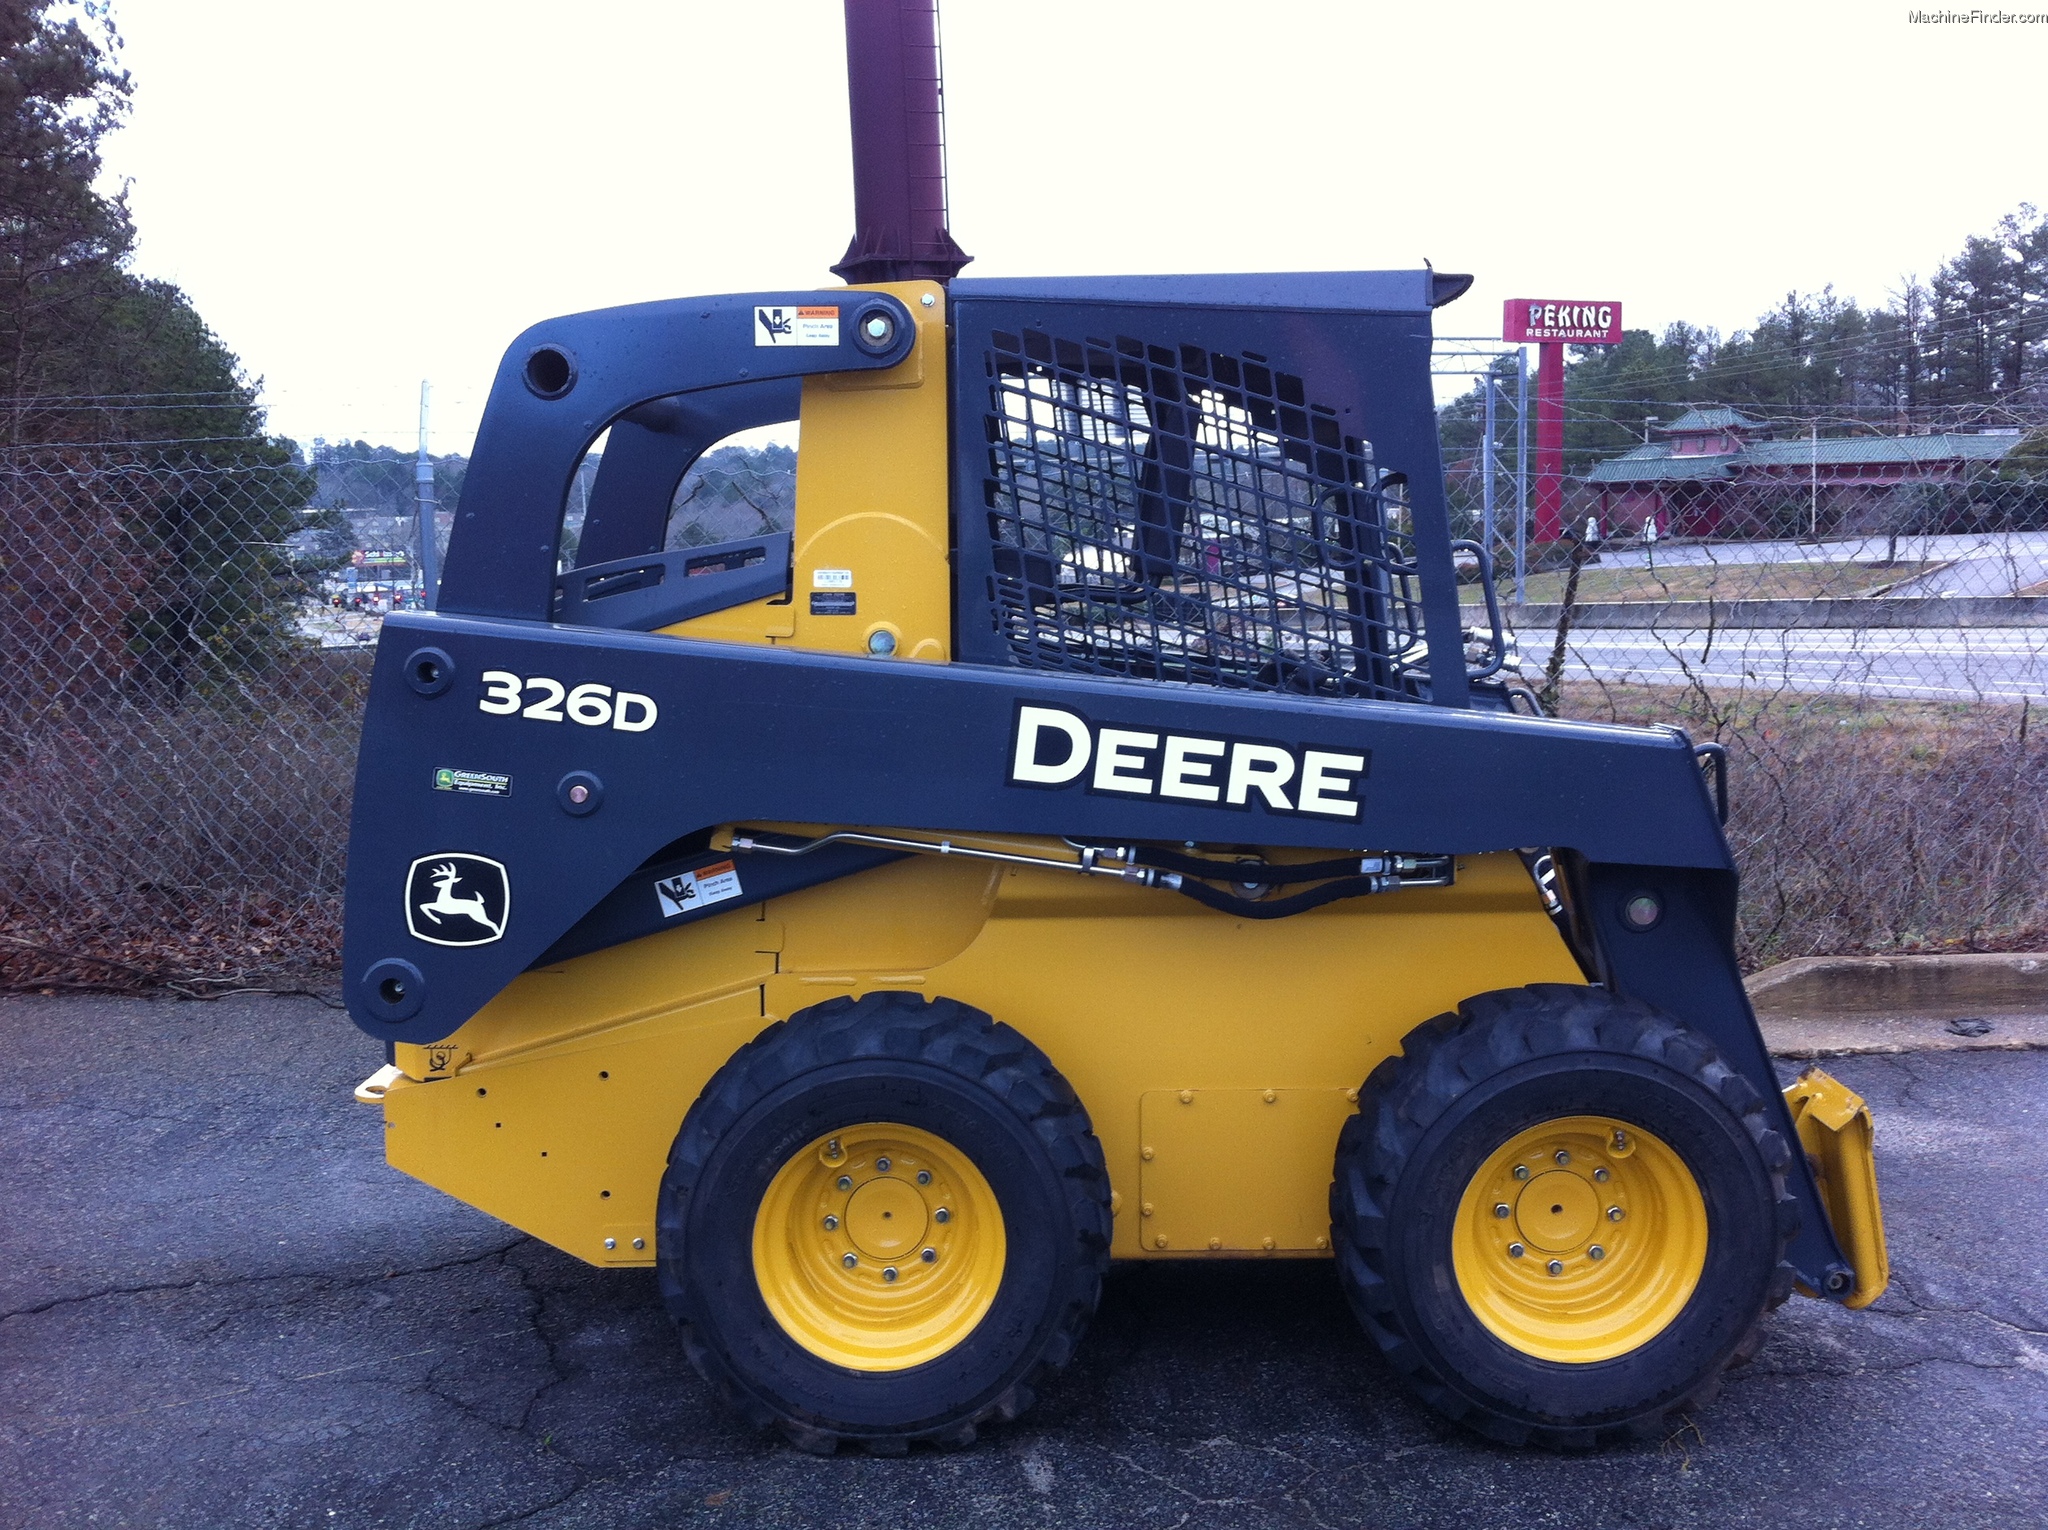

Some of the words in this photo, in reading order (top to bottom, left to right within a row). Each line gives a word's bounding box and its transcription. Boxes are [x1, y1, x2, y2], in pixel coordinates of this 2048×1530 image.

[1526, 328, 1609, 338] RESTAURANT
[1528, 304, 1612, 329] PEKING
[479, 670, 658, 732] 326D
[1012, 705, 1365, 817] DEERE
